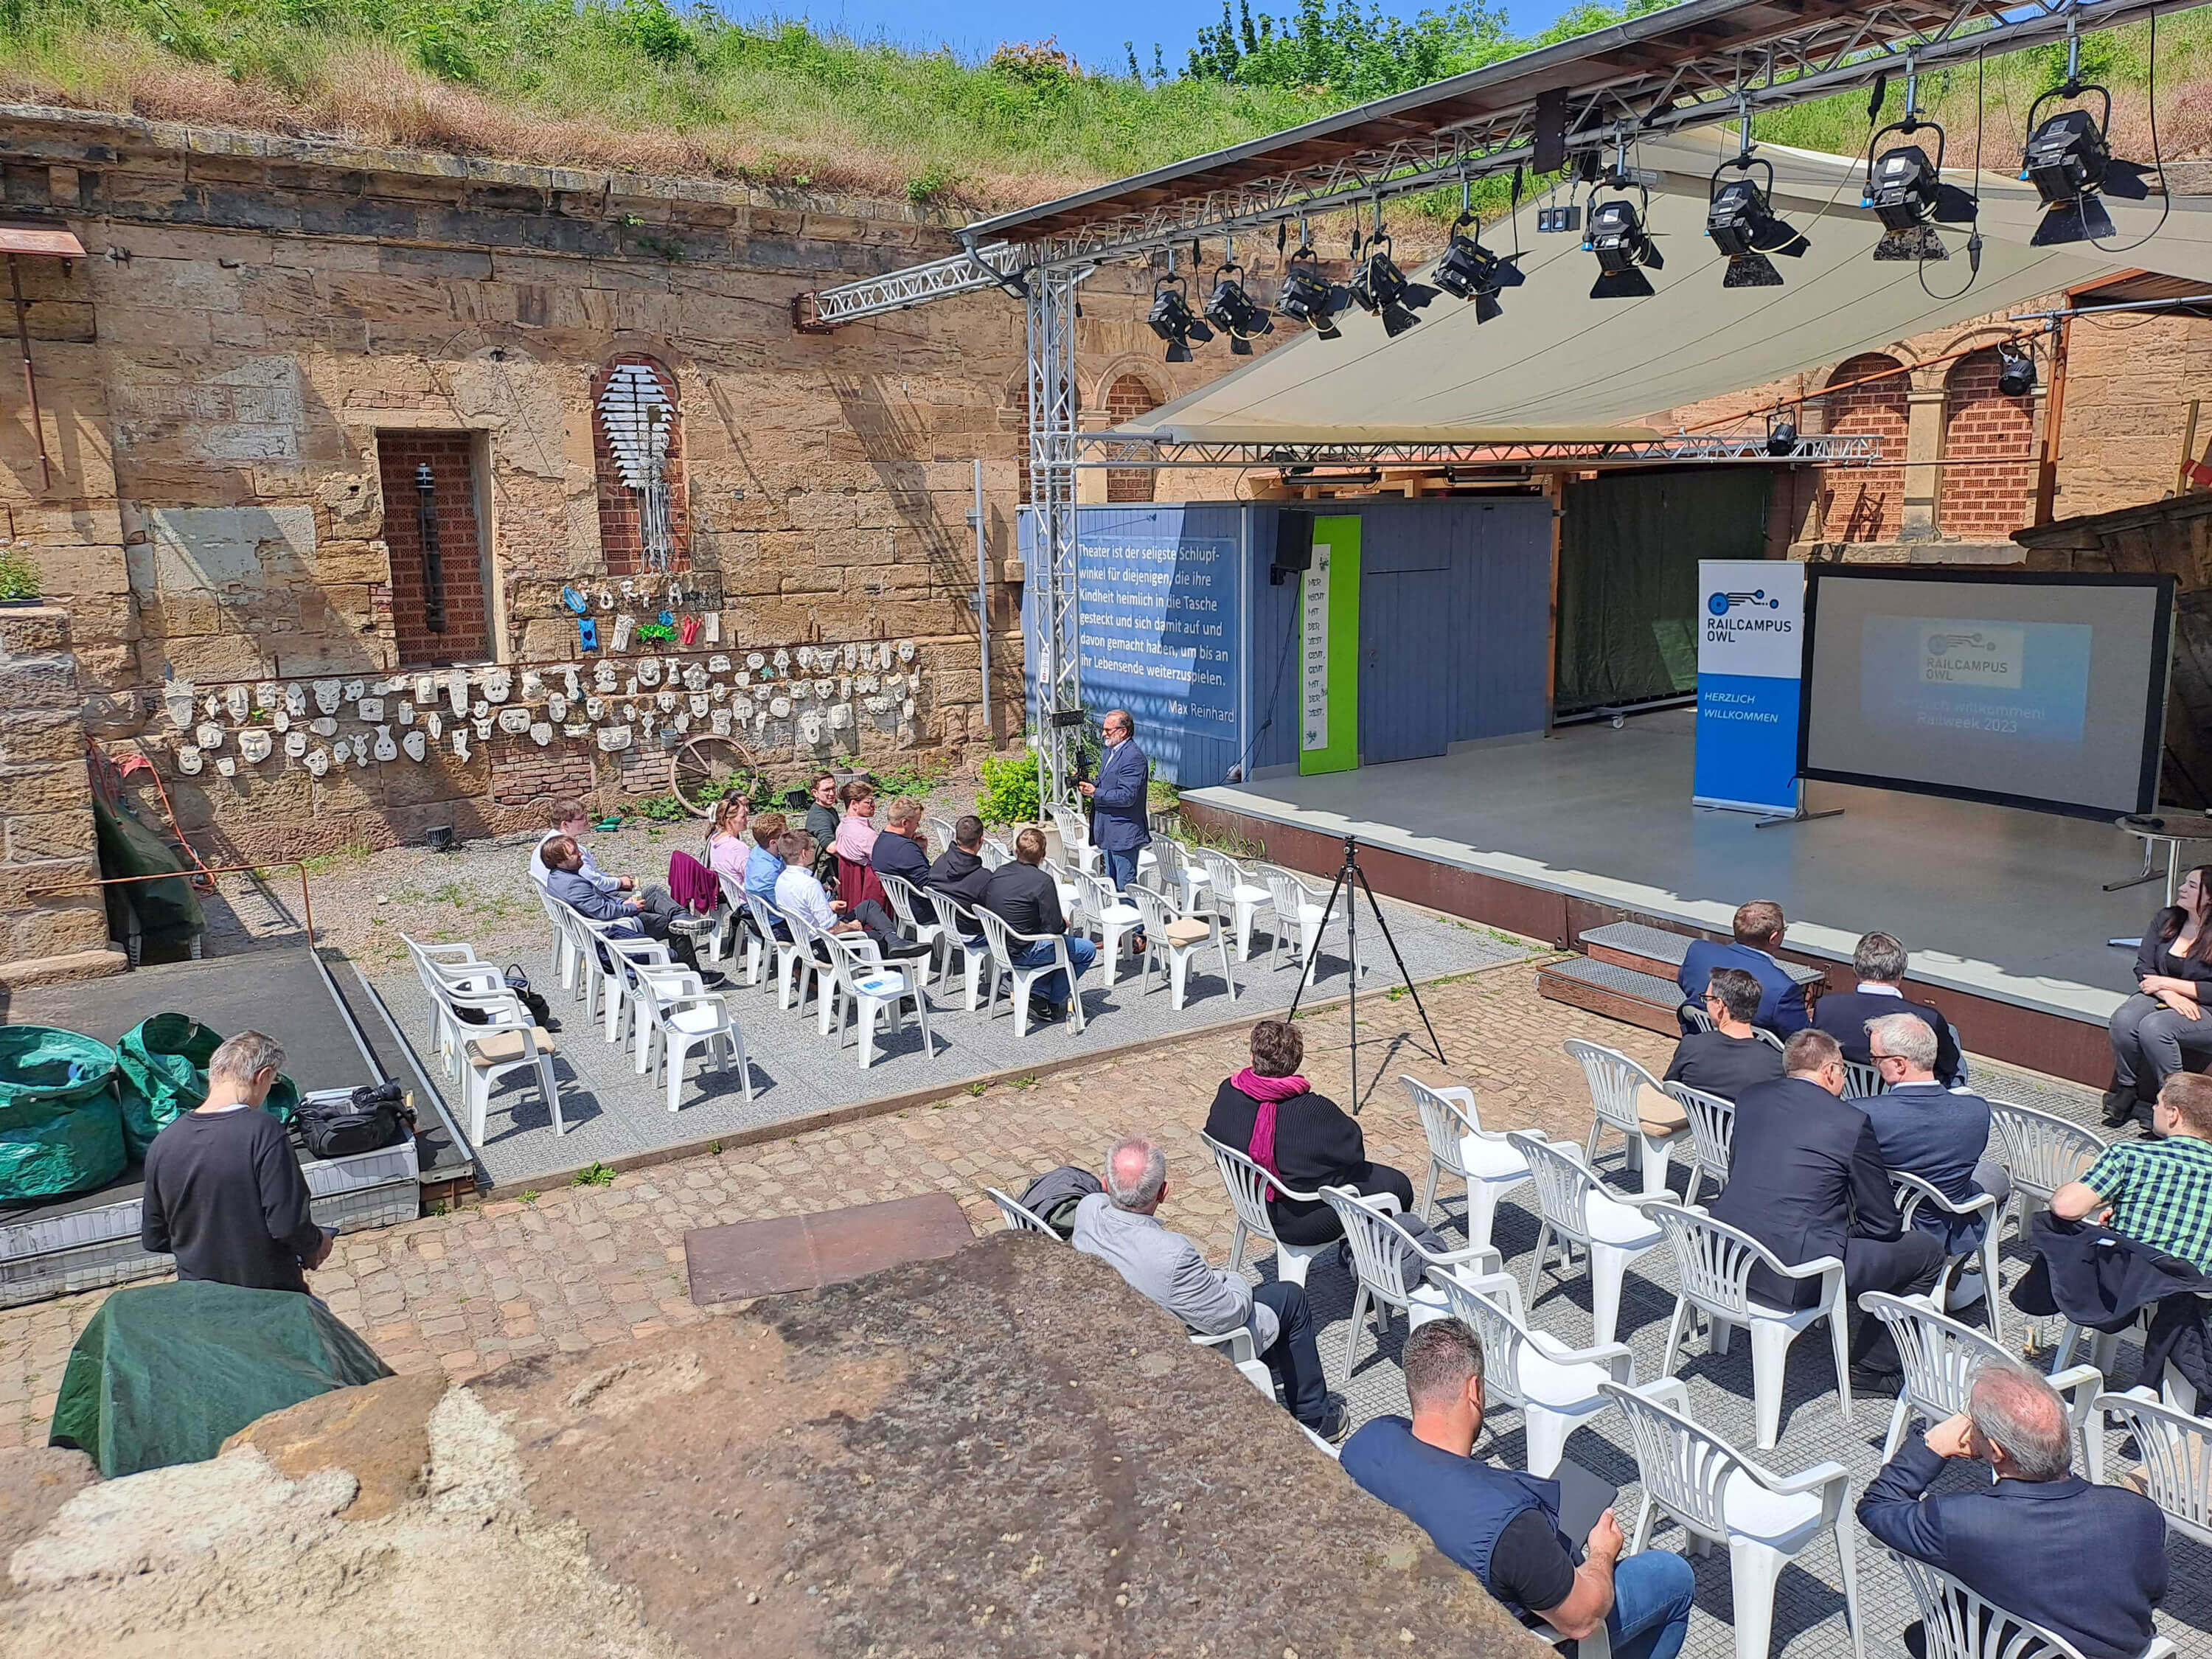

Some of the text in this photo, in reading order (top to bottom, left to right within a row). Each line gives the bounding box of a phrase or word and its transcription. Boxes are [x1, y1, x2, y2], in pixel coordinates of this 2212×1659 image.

[1078, 543, 1220, 565] Theater ist der seligste Schlupf-
[1079, 566, 1211, 587] winkel für diejenigen, die ihre
[1079, 588, 1217, 611] Kindheit heimlich in die Tasche
[1079, 612, 1222, 636] gesteckt und sich damit auf und
[1707, 618, 1792, 633] RAILCAMPUS
[1707, 630, 1736, 643] OWL
[1080, 631, 1228, 662] davon gemacht haben, um bis an
[1080, 653, 1226, 686] ihr Lebensende weiterzuspielen.
[1926, 657, 2008, 674] RAILCAMPUS
[1926, 668, 1953, 681] OWL
[1705, 692, 1756, 703] HERZLICH
[1168, 699, 1234, 723] Max Reinhard
[1705, 709, 1778, 723] WILLKOMMEN
[1983, 717, 2018, 734] 2023
